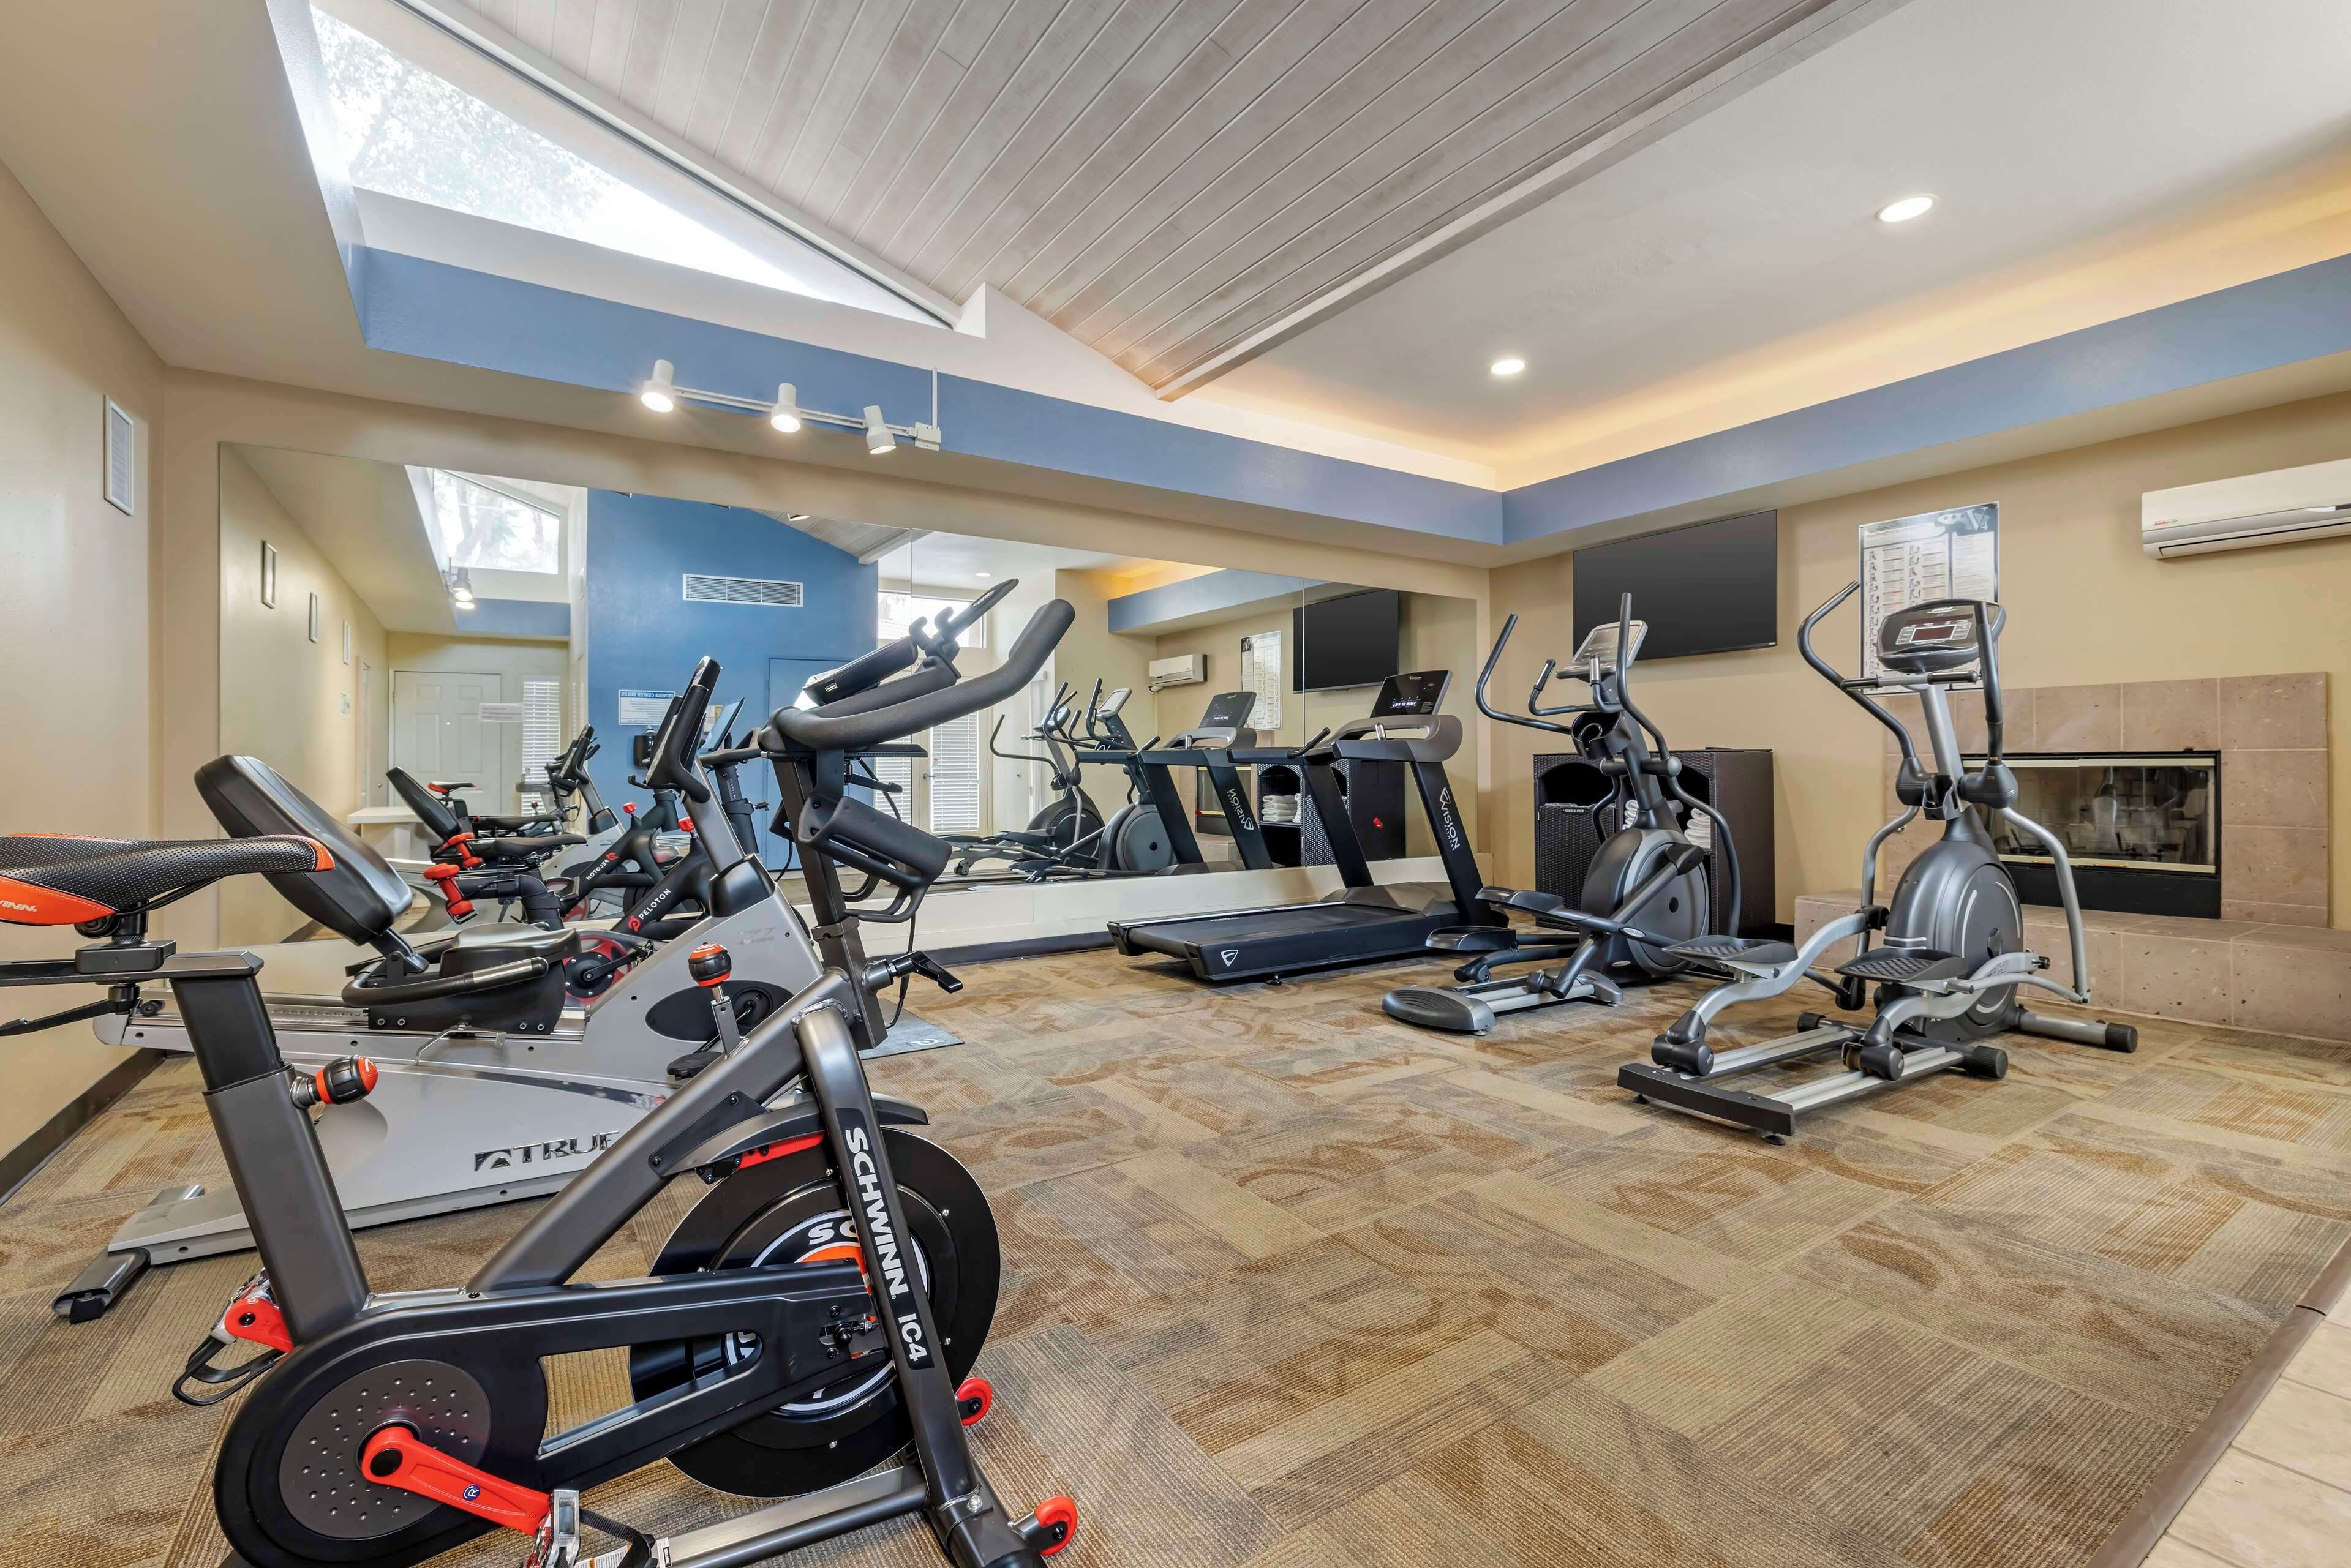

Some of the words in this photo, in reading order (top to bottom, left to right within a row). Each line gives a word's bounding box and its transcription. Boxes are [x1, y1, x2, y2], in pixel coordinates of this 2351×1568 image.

[1440, 803, 1461, 849] VISION
[638, 888, 671, 920] PELOTON
[844, 1126, 909, 1297] SCHWINN
[895, 1312, 927, 1362] IC4
